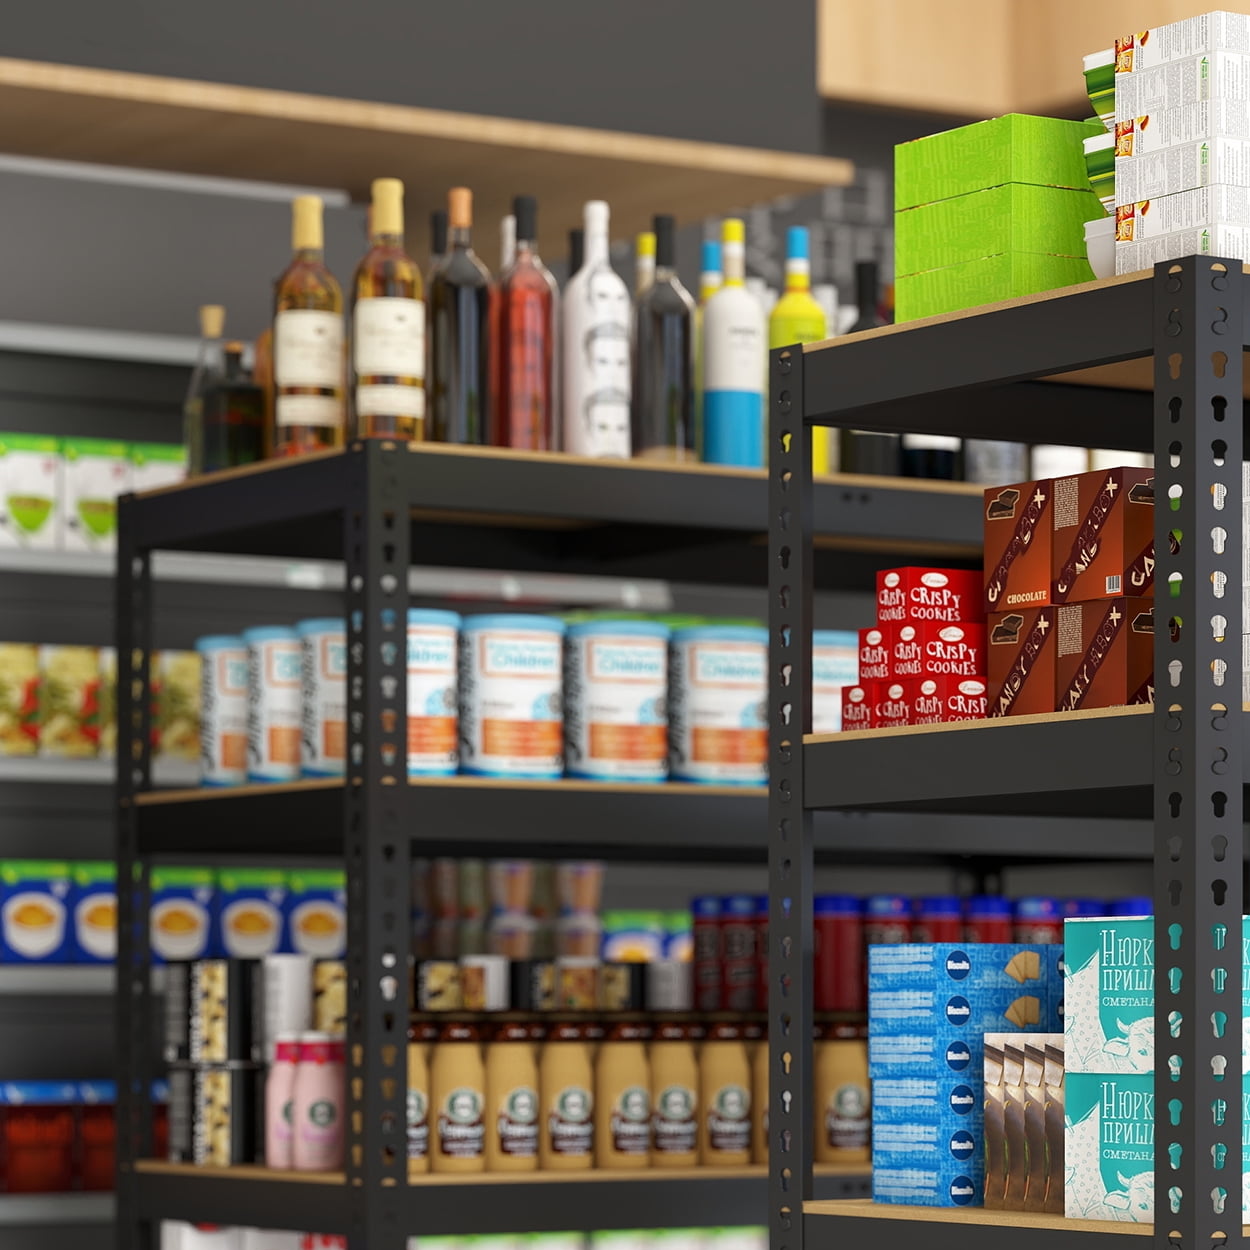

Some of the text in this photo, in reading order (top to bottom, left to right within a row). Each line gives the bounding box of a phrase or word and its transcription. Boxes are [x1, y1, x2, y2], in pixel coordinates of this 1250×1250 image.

[879, 589, 906, 606] CRISPY
[910, 587, 960, 609] CRISPY
[1007, 591, 1047, 604] CHOCOLATE
[880, 606, 906, 621] COOKIES
[910, 606, 960, 622] COOKIES
[860, 646, 889, 664] CRISPY
[894, 643, 922, 660] CRISPY
[926, 642, 976, 662] CRISPY
[894, 660, 922, 674] COOKIES
[926, 660, 976, 676] COOKIES
[915, 696, 943, 714] CRISPY
[948, 696, 988, 714] CRISP
